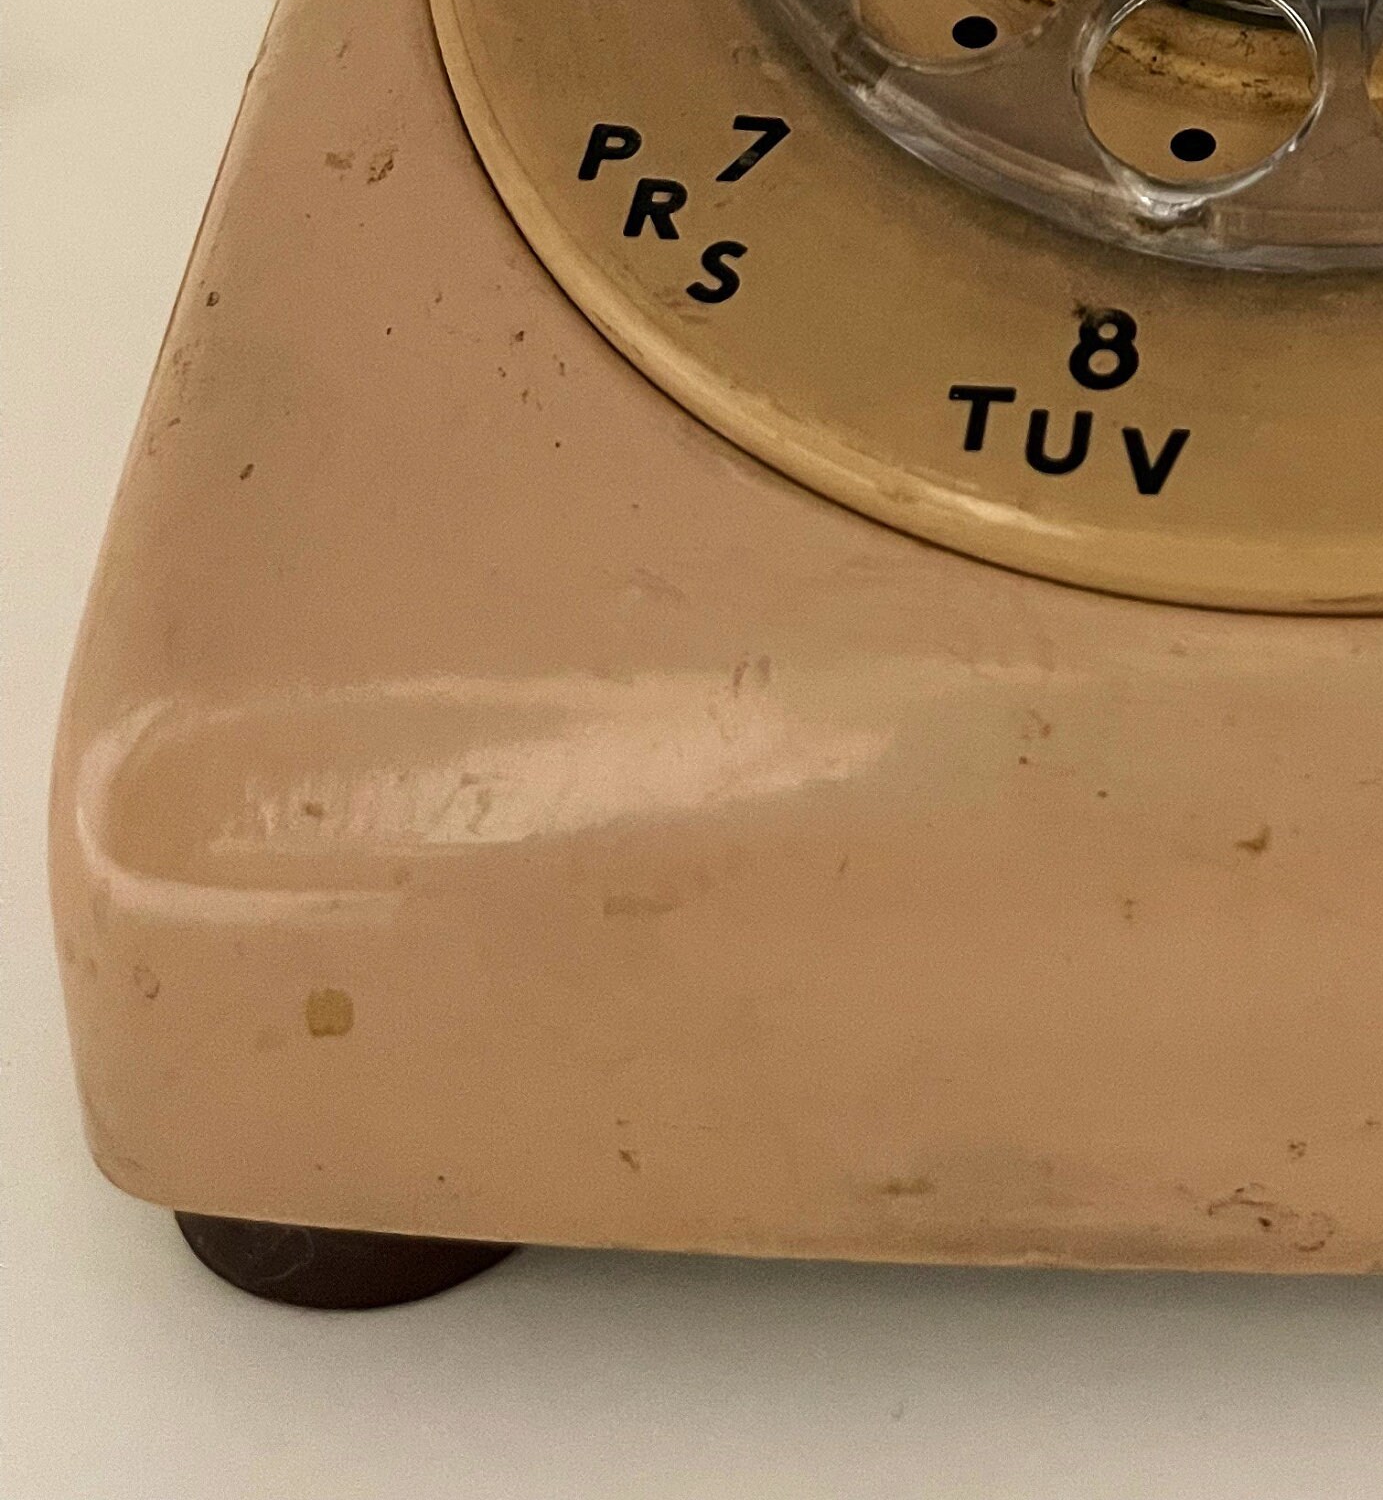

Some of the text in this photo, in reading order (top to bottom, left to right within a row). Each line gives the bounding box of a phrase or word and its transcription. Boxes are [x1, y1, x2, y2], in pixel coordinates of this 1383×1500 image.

[715, 115, 791, 182] 7
[577, 123, 748, 304] PRS
[1069, 309, 1139, 390] 8
[948, 385, 1191, 495] TUV
